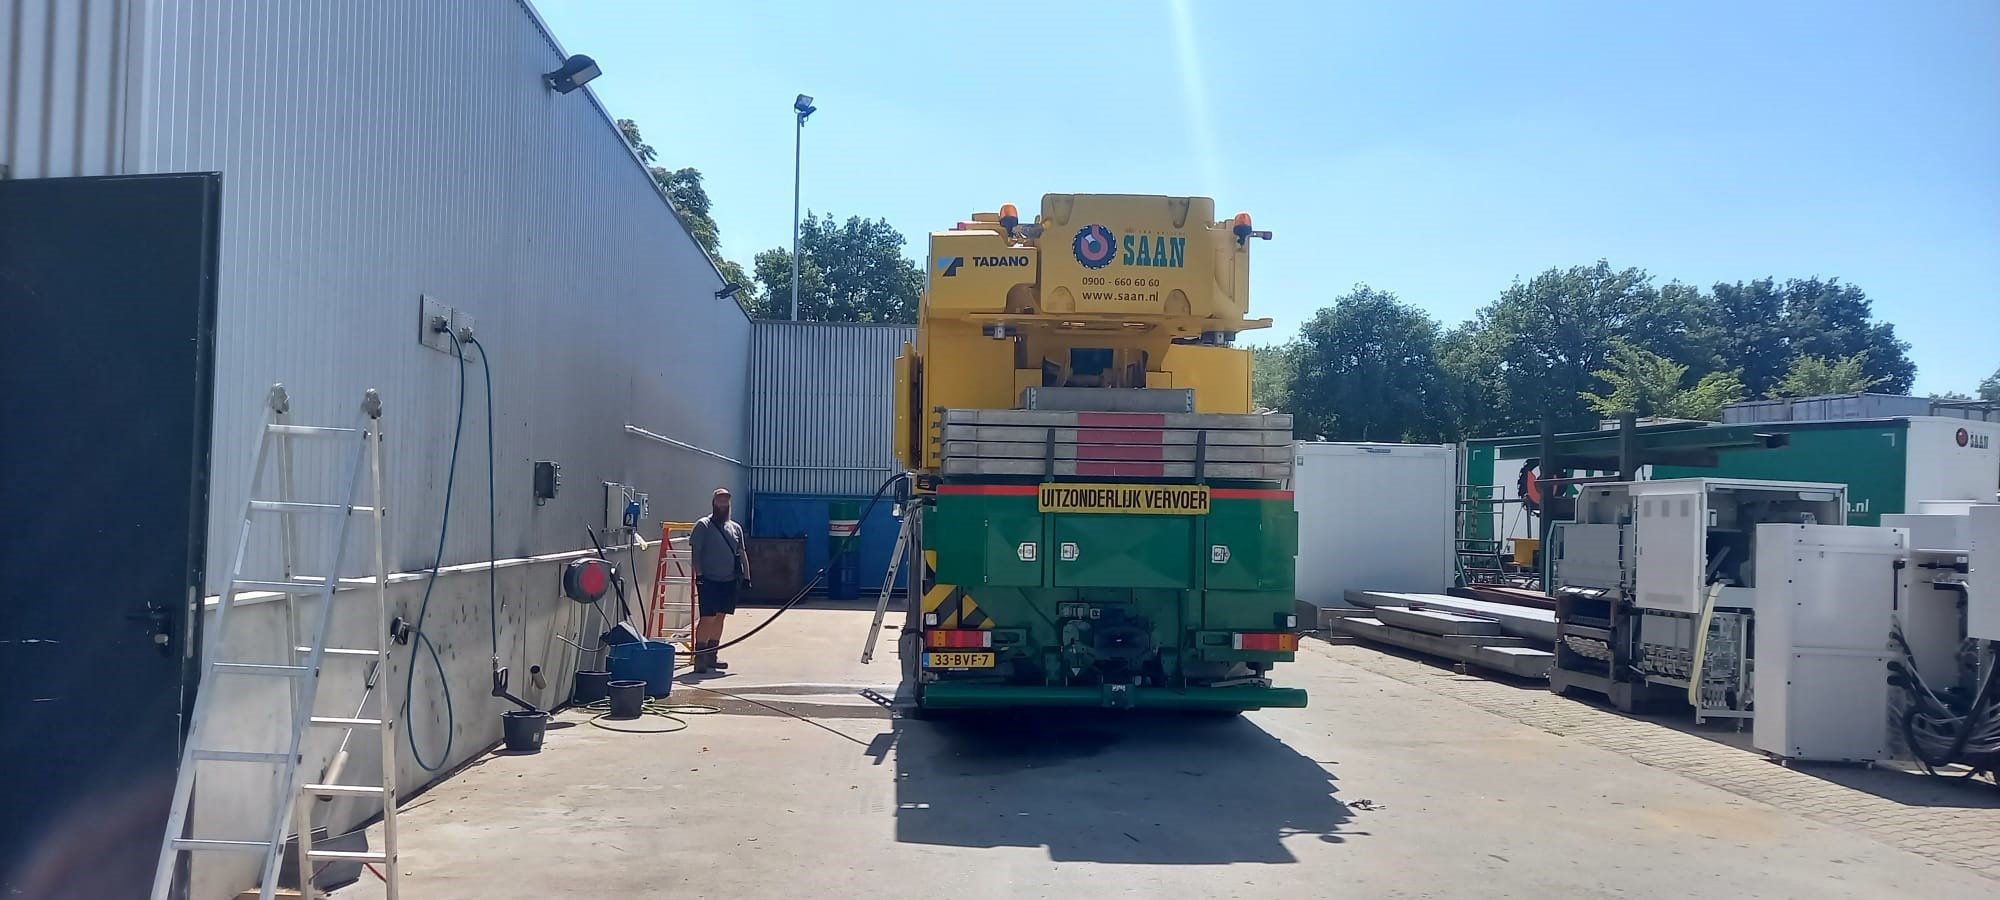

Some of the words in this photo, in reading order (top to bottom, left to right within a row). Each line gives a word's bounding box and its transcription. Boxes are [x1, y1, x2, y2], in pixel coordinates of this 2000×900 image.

[1123, 234, 1186, 268] SAAN
[972, 256, 1029, 267] TADANO
[1082, 277, 1105, 286] 0900
[1114, 278, 1132, 287] 660
[1134, 279, 1146, 287] 60
[1148, 279, 1160, 288] 60
[1082, 291, 1159, 302] www.saan.nl
[1041, 488, 1142, 508] UITZONDERLIJK
[1144, 490, 1208, 509] VERVOER
[935, 654, 989, 666] 33-BVF-7
